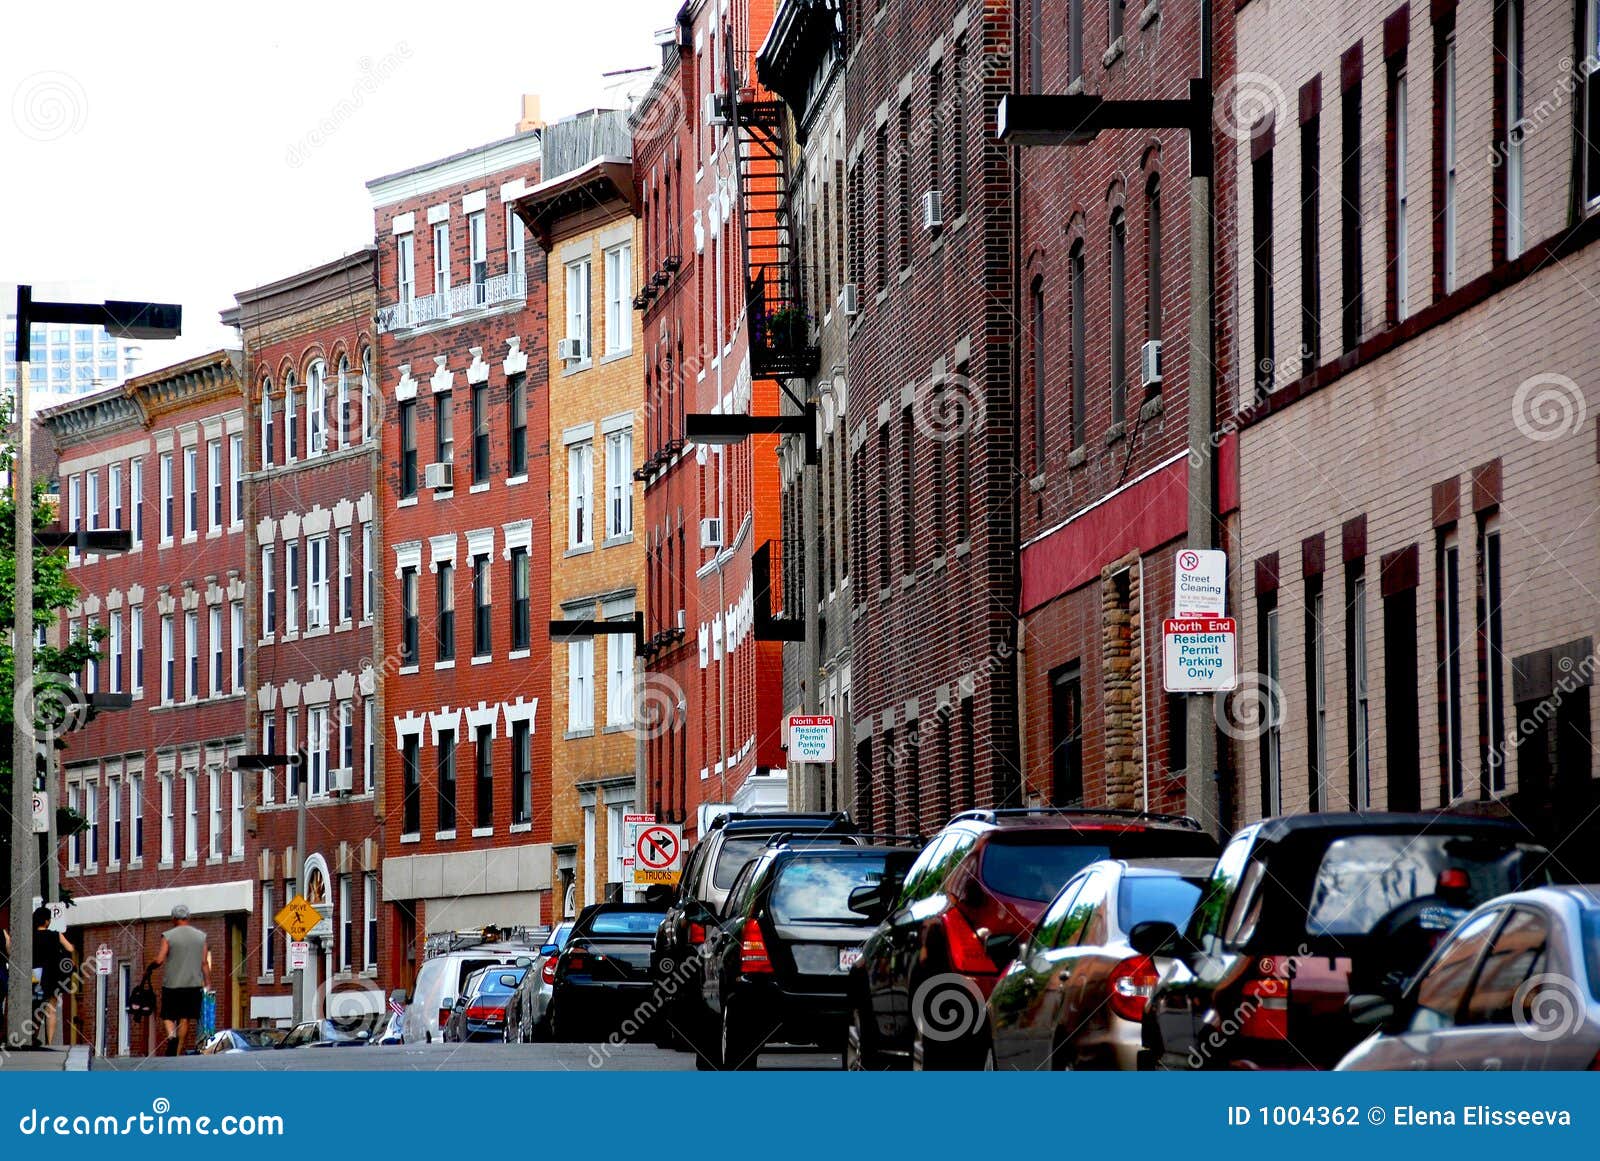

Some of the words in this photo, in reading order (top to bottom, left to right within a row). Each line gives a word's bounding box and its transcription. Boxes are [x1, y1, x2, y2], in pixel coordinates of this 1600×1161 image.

[1181, 574, 1210, 583] Street
[1180, 583, 1221, 595] Cleaning
[1170, 621, 1202, 632] North
[1209, 621, 1230, 631] End
[1174, 634, 1226, 644] Resident
[1181, 645, 1219, 655] Permit
[1179, 656, 1223, 667] Parking
[1187, 667, 1214, 679] Only
[798, 741, 826, 749] Parking
[803, 748, 820, 756] Only
[644, 871, 672, 881] TRUCKS
[289, 904, 307, 912] DRIVE
